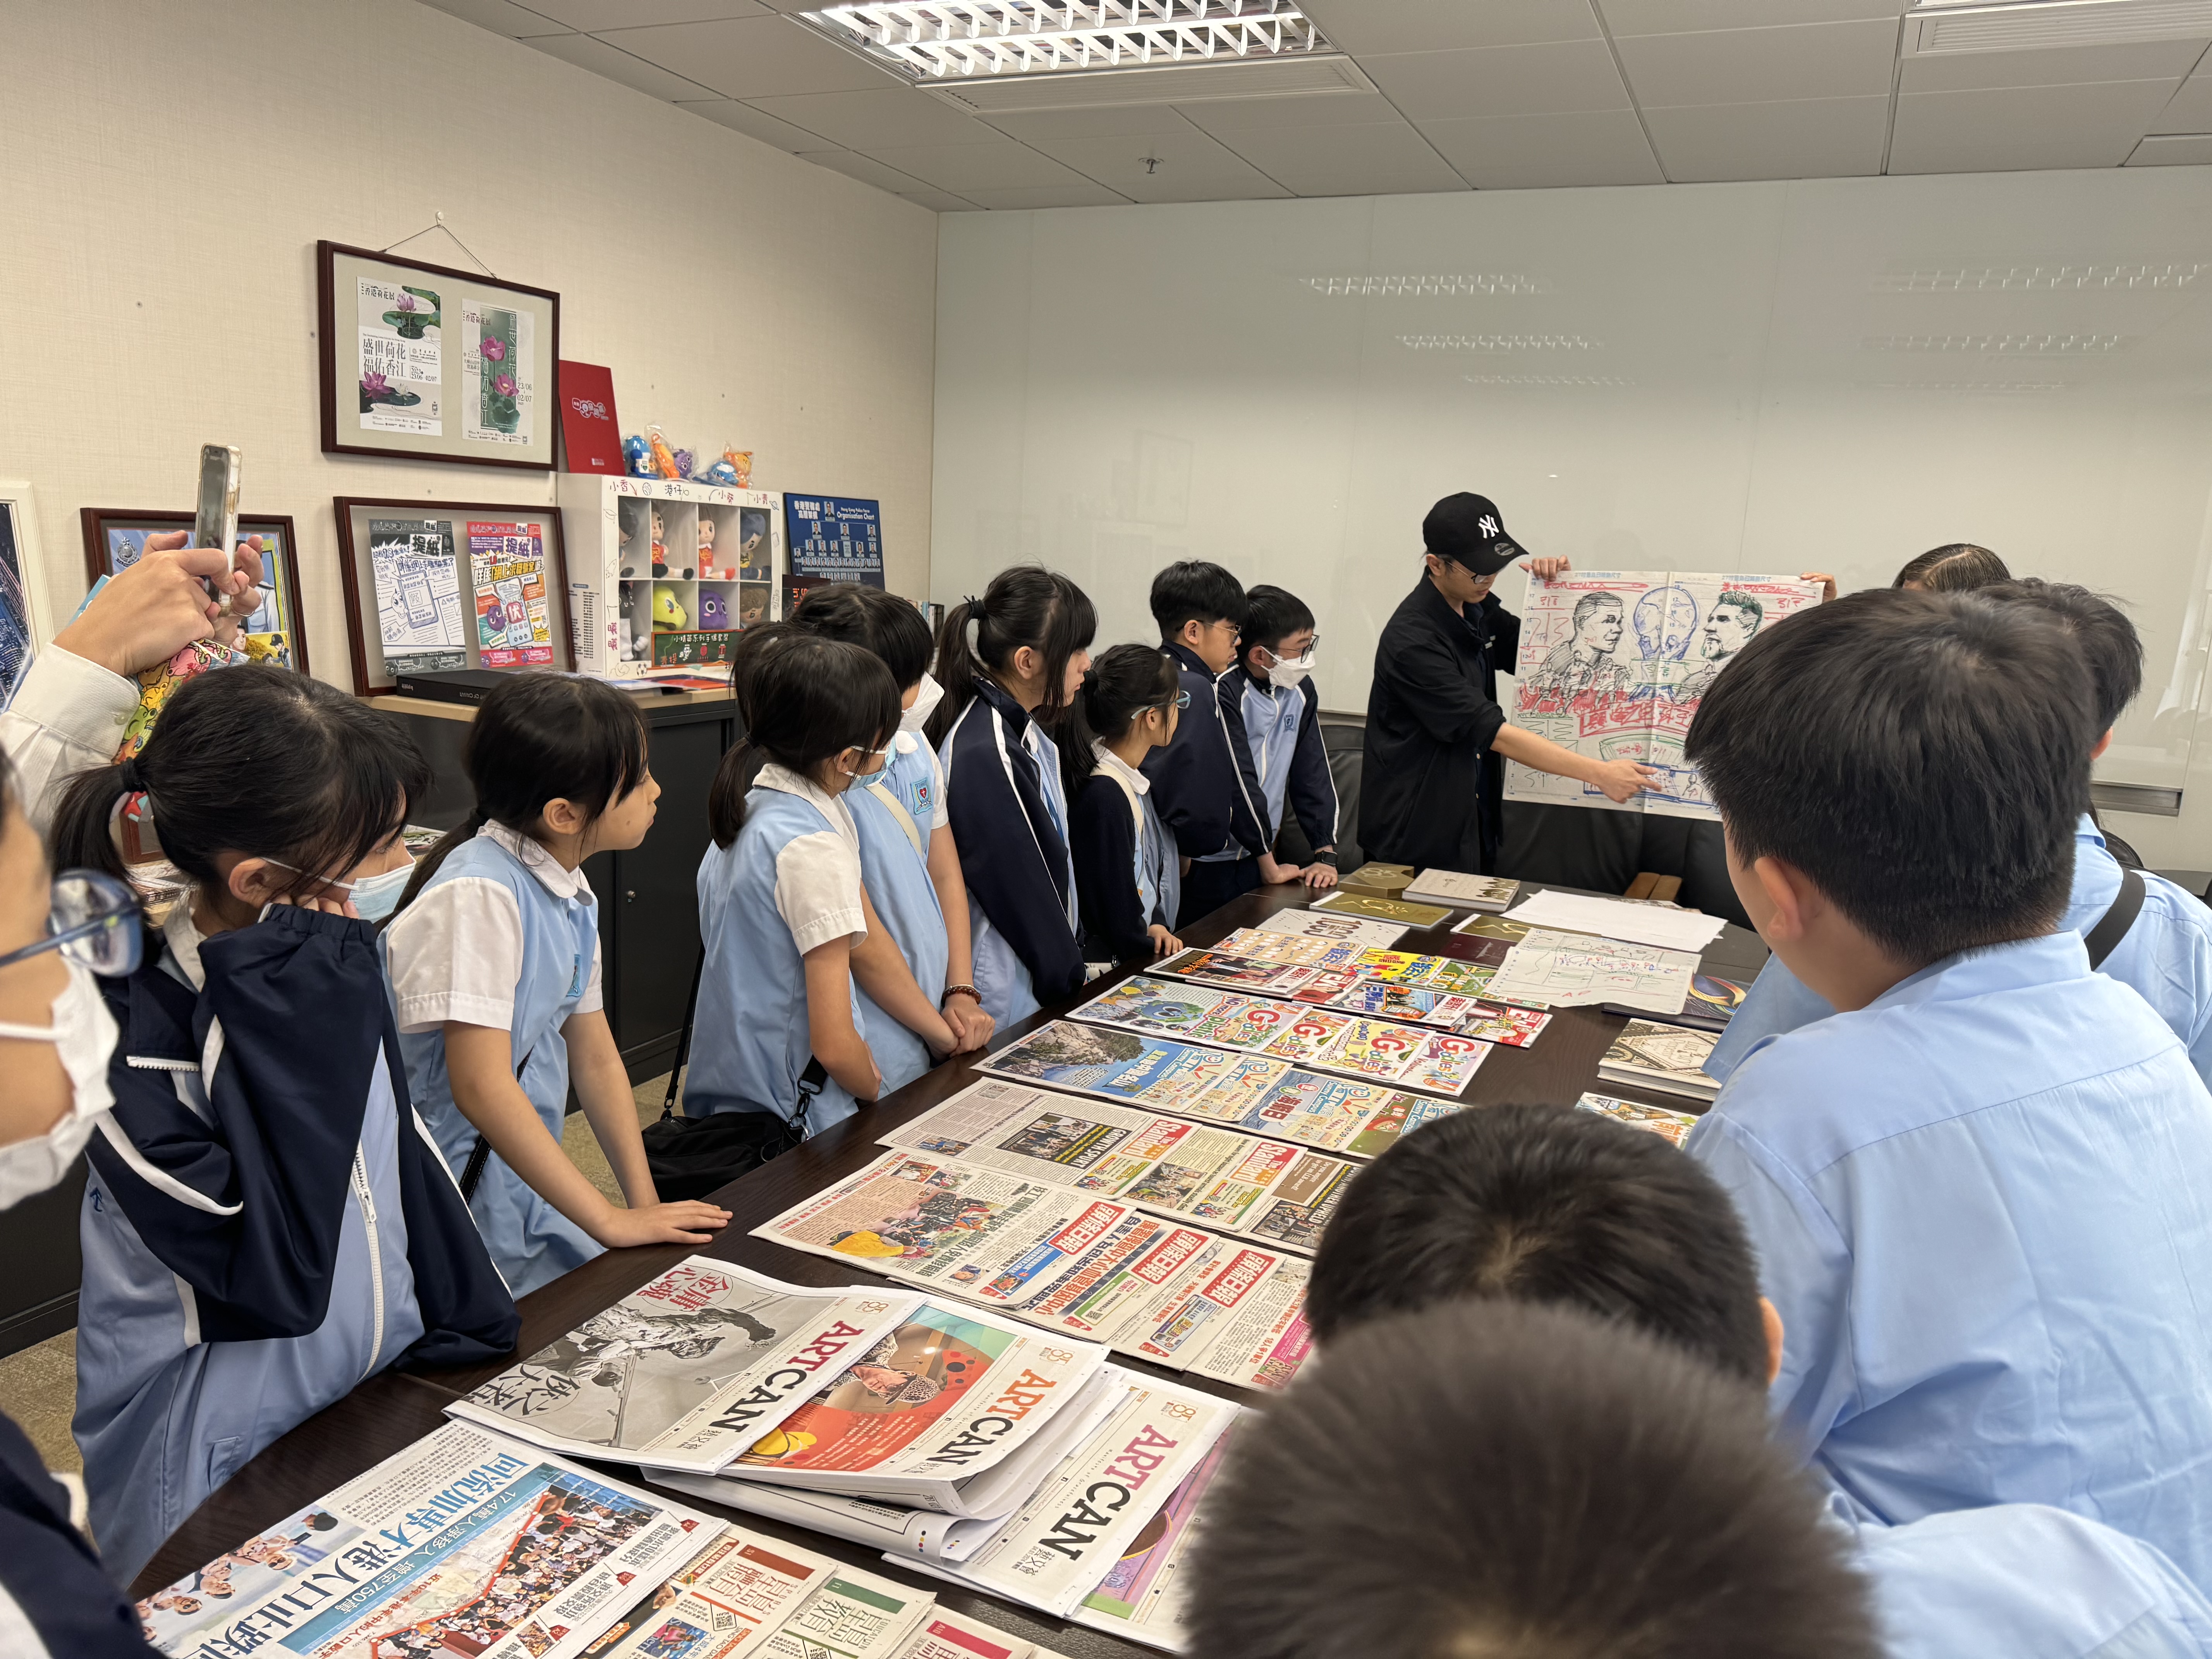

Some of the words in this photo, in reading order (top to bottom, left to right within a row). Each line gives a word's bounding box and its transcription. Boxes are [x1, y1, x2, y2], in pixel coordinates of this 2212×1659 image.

[363, 338, 406, 360] 盛世荷花
[364, 356, 406, 377] 福佑香江
[517, 383, 532, 391] 23/06
[517, 395, 532, 403] 02/07
[665, 484, 682, 496] 港仔
[1478, 514, 1499, 539] NY
[508, 603, 523, 621] 伏
[1209, 1005, 1231, 1015] more
[1221, 995, 1250, 1006] No
[1184, 1015, 1228, 1039] plastic
[1232, 1009, 1287, 1042] Goodies
[1273, 1024, 1324, 1056] Goodies
[1158, 1061, 1184, 1078] Campus
[1175, 1048, 1196, 1062] Sunny
[1364, 1037, 1405, 1072] Goodies
[1438, 1037, 1476, 1073] Goodies
[1306, 1095, 1329, 1113] Campus
[1318, 1081, 1339, 1095] Sunny
[1401, 1114, 1421, 1134] Campus
[1411, 1100, 1429, 1115] Sunny
[1090, 1127, 1128, 1152] GROWTH
[1120, 1120, 1182, 1159] Standard
[1157, 1134, 1177, 1145] The
[1070, 1148, 1101, 1168] SPURT
[1231, 1143, 1287, 1183] Standard
[1266, 1159, 1283, 1169] The
[1053, 1203, 1120, 1253] 頭條日報
[1307, 1202, 1332, 1224] UPHELD
[1136, 1231, 1203, 1282] 頭條日報
[636, 1267, 697, 1300] 心魂
[670, 1271, 730, 1312] 金庸
[1205, 1252, 1271, 1305] 頭條日報
[471, 1364, 544, 1407] 大者
[706, 1320, 869, 1433] ARTCAN
[501, 1374, 582, 1416] 俠之
[924, 1368, 1058, 1466] ARTCAN
[1037, 1424, 1178, 1561] ARTCAN
[412, 1490, 518, 1559] 17.4萬人淨移入
[330, 1560, 419, 1614] 增至750萬
[550, 1571, 613, 1615] 研谷股票交投
[702, 1563, 766, 1601] 體育
[731, 1574, 794, 1612] 星島
[316, 1571, 443, 1659] 近10年本港年中的人口數字
[560, 1582, 613, 1619] 港交所發功
[760, 1583, 800, 1616] SPORTS
[793, 1597, 856, 1635] 教育
[826, 1607, 885, 1647] 星島
[855, 1618, 892, 1650] EDUCATION
[930, 1623, 948, 1634] A10
